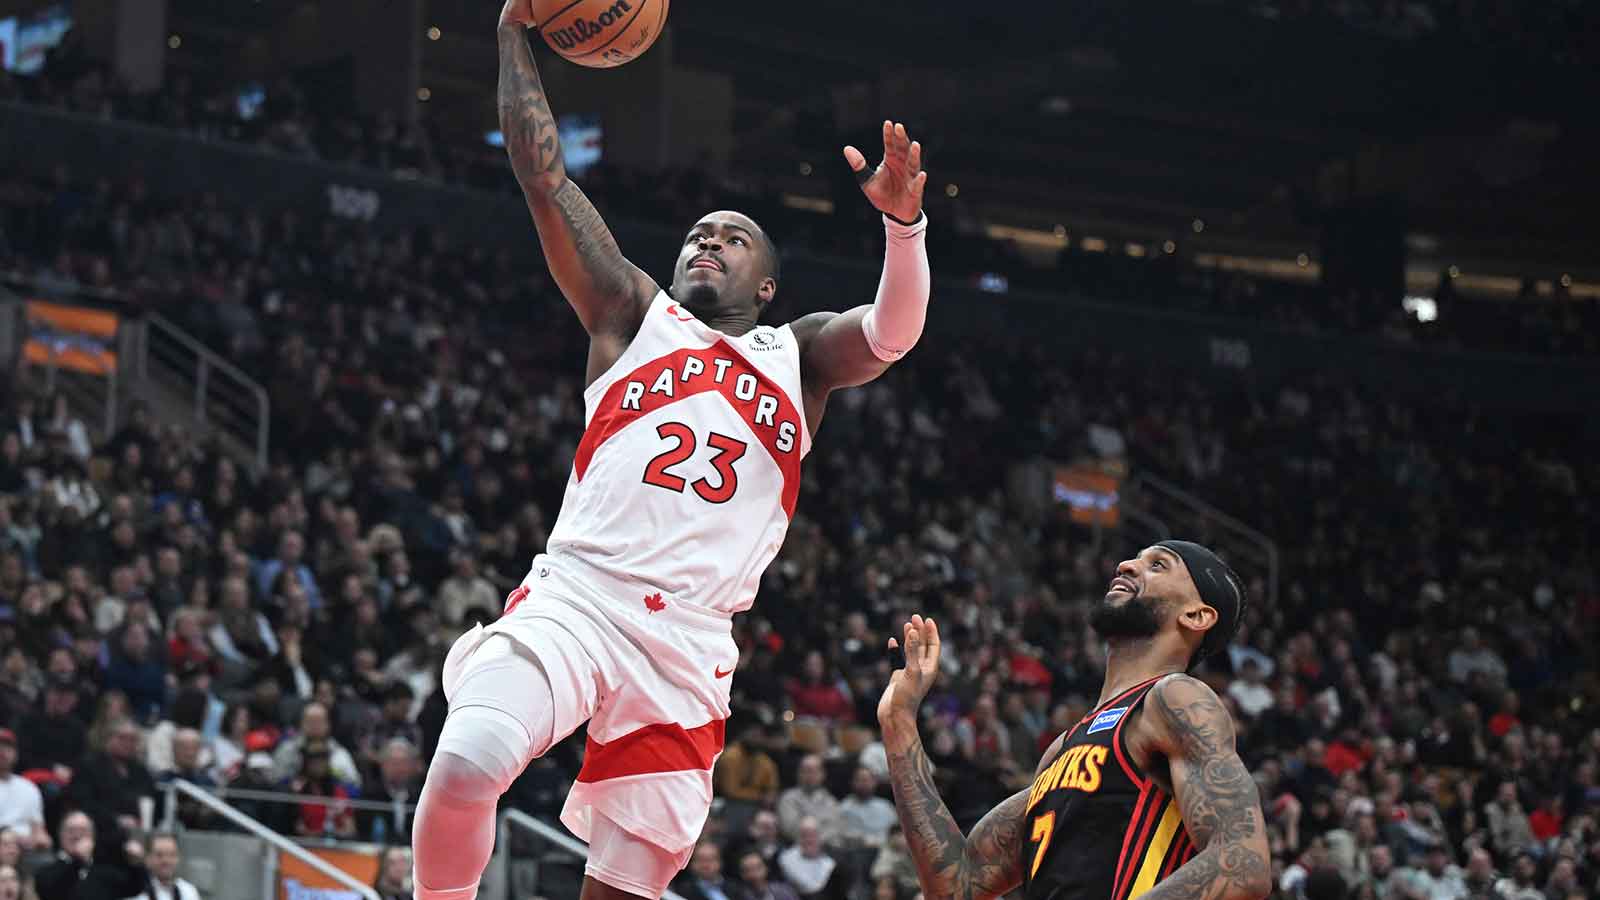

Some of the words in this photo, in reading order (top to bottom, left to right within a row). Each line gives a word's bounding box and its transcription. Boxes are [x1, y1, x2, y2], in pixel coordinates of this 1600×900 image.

[547, 0, 632, 49] Wilson
[620, 354, 797, 454] RAPTORS
[642, 421, 748, 504] 23
[1030, 809, 1057, 881] 7
